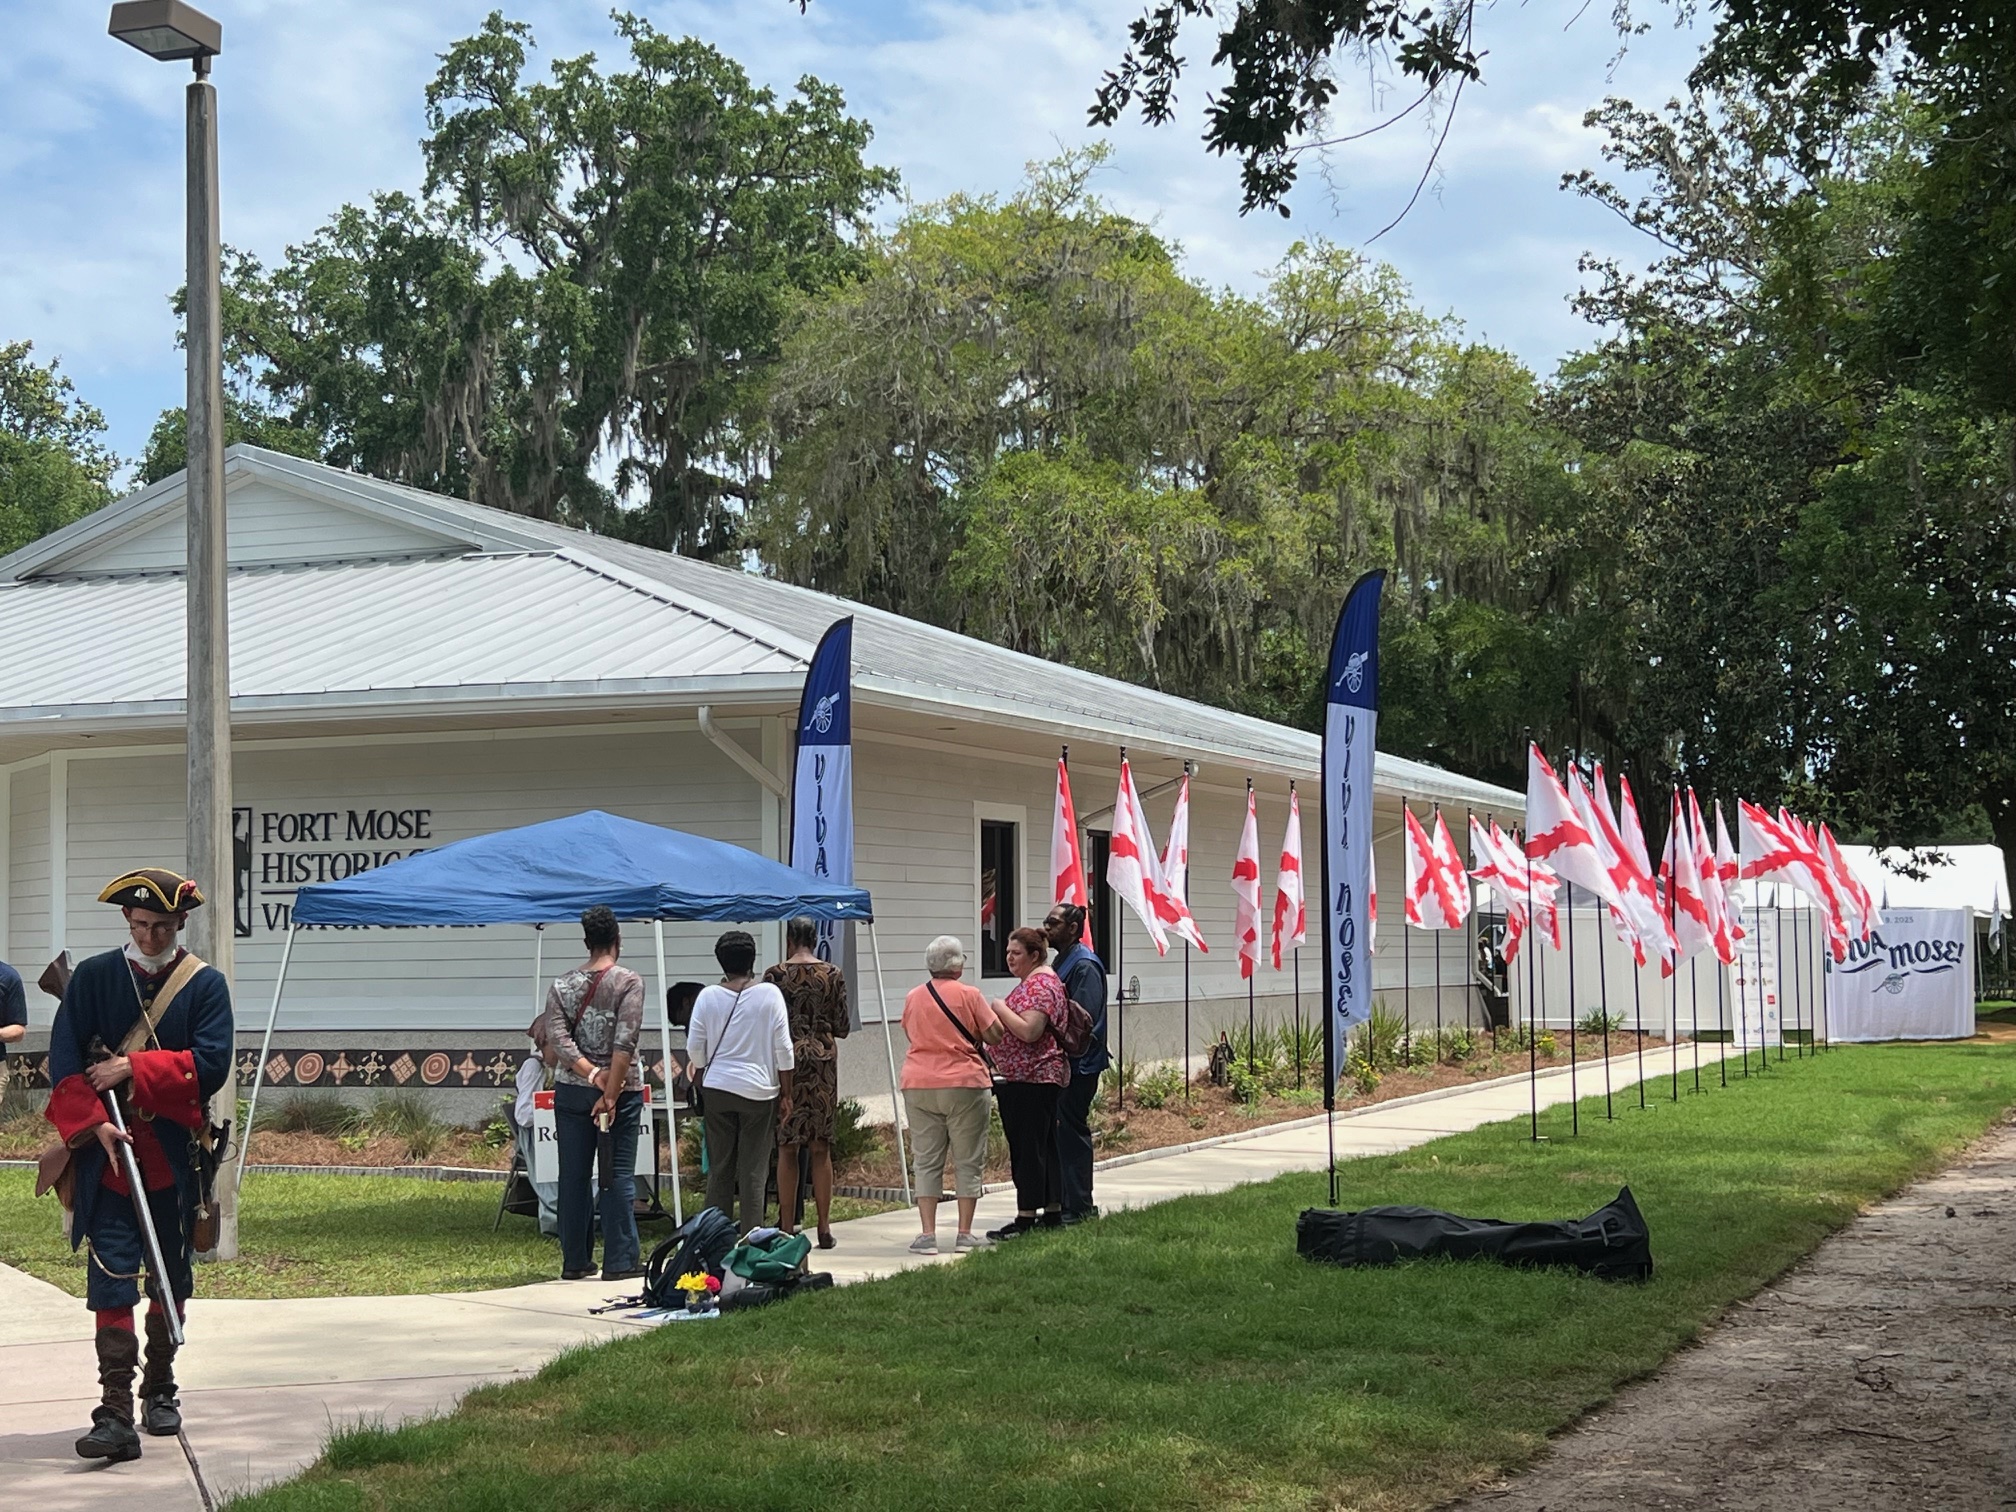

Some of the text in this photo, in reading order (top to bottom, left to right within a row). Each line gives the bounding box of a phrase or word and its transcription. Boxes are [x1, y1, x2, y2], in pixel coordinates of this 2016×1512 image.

[261, 809, 432, 844] FORT MOSE
[814, 753, 829, 878] VIVA
[1894, 916, 1914, 924] 2025
[1826, 930, 1965, 974] ¡IVA MOSE!
